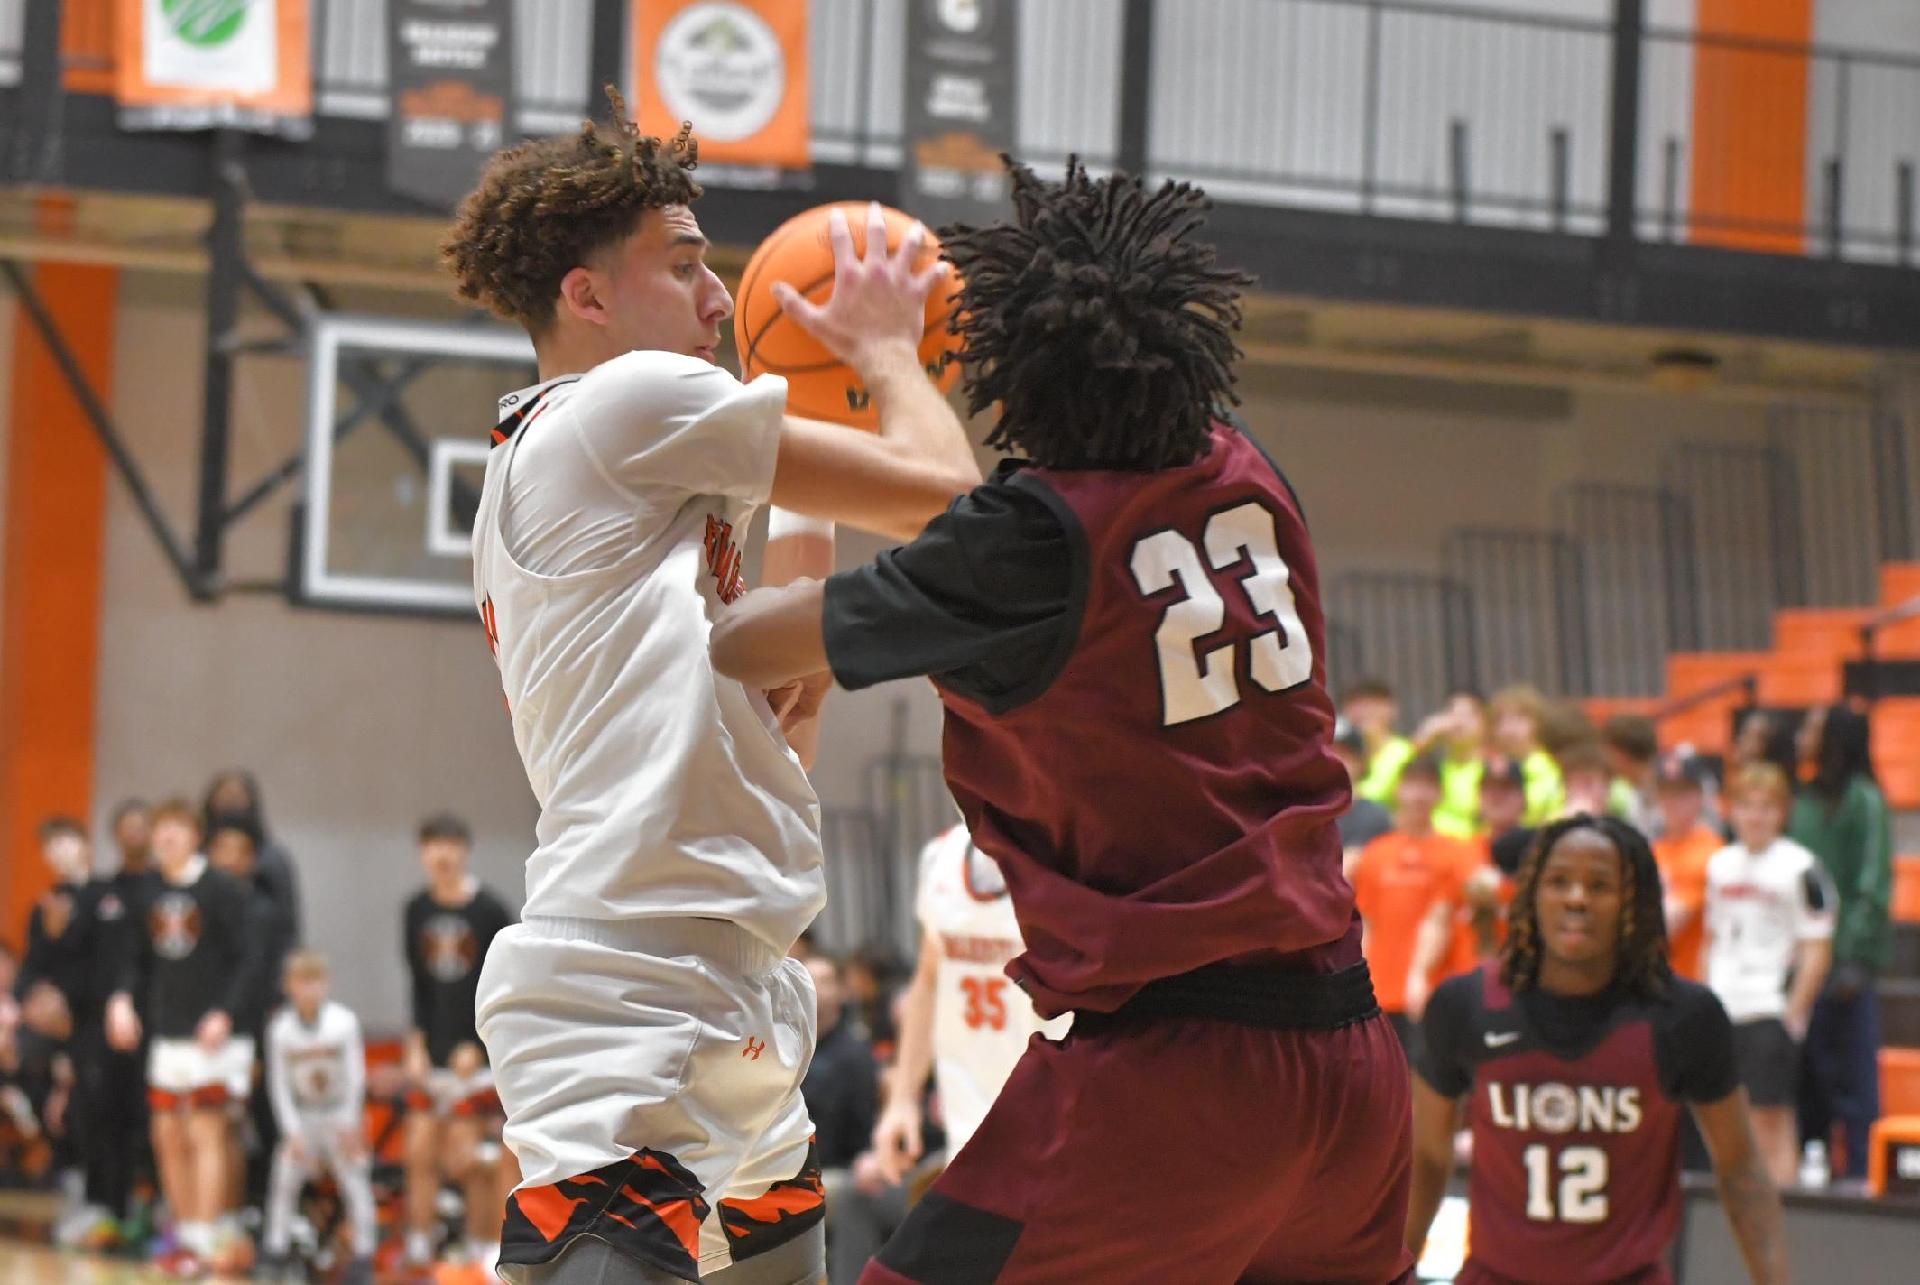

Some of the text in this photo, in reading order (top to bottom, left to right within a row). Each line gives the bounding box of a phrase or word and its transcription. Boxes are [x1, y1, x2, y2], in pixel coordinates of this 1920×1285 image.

[1129, 500, 1314, 728] 23
[960, 975, 1008, 1031] 35
[1487, 1081, 1642, 1134] LIONS
[1523, 1144, 1609, 1223] 12
